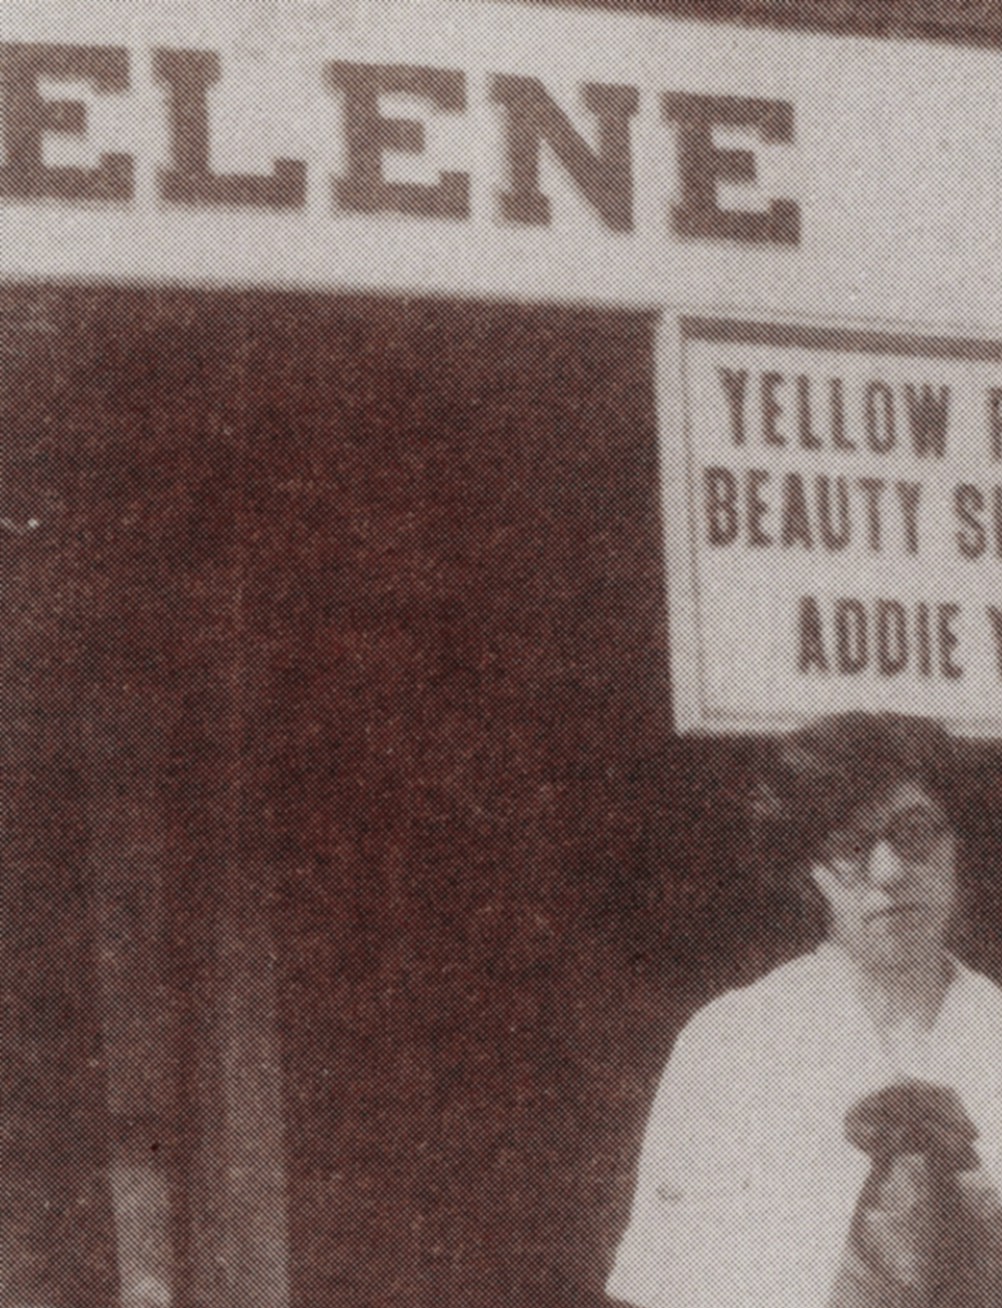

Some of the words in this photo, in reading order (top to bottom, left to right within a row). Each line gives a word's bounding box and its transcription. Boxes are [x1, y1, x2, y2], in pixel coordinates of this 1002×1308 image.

[0, 40, 801, 247] ELENE
[717, 366, 950, 459] YELLOW
[703, 465, 922, 556] BEAUTY
[798, 596, 964, 681] ADDIE
